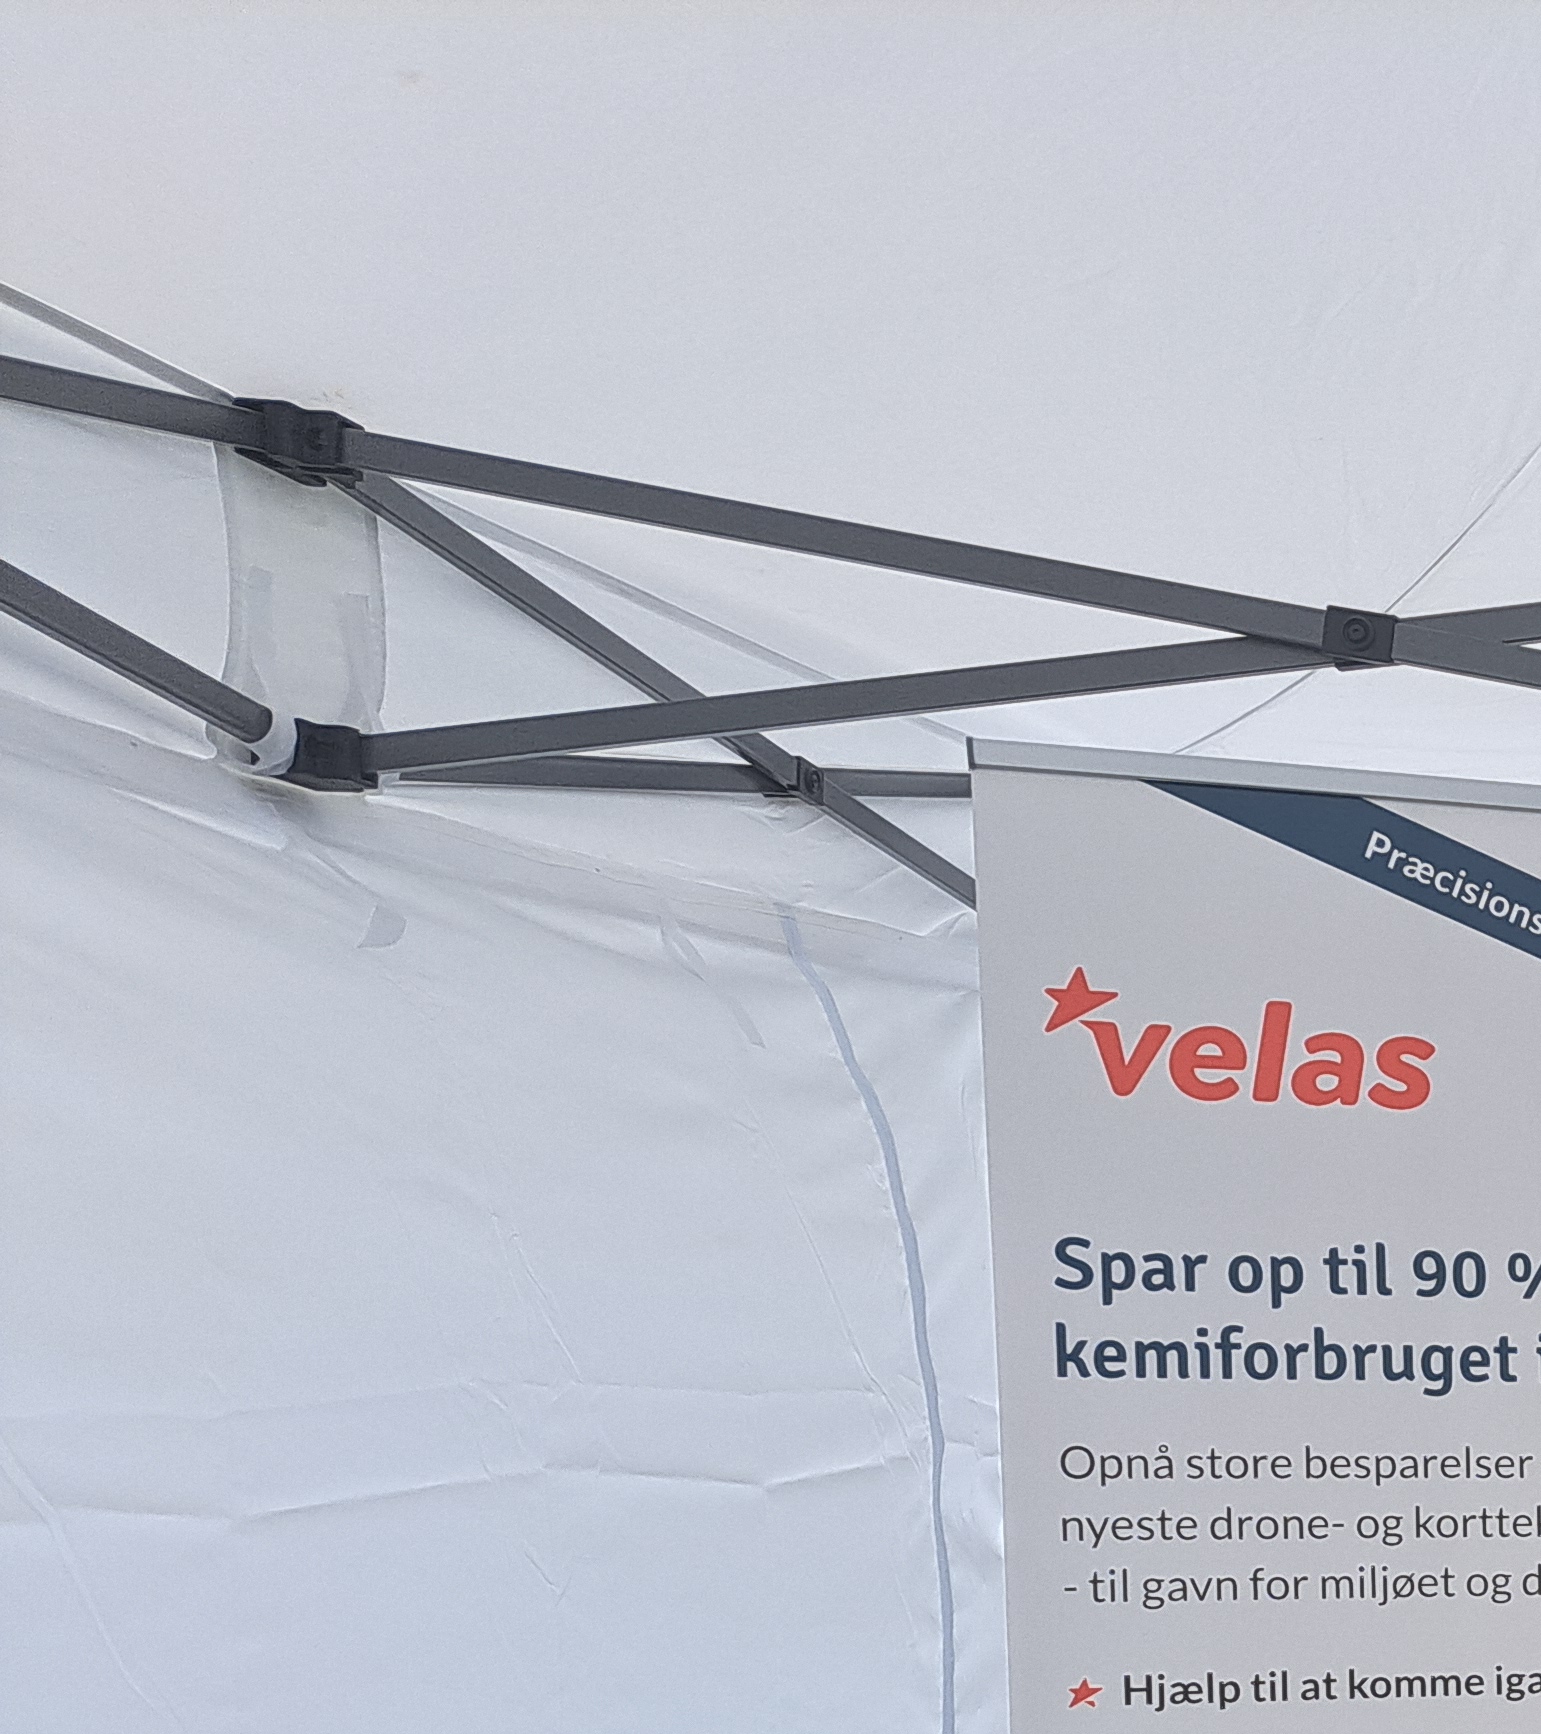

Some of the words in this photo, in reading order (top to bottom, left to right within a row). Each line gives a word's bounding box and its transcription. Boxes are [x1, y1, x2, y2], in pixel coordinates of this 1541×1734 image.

[1078, 1000, 1436, 1110] velas
[1054, 1236, 1208, 1306] Spar
[1228, 1254, 1304, 1310] op
[1322, 1241, 1393, 1297] til
[1412, 1249, 1487, 1299] 90
[1055, 1321, 1518, 1397] kemiforbruget
[1060, 1444, 1174, 1487] Opnå
[1186, 1448, 1292, 1480] store
[1305, 1445, 1534, 1487] besparelser
[1061, 1509, 1198, 1549] nyeste
[1209, 1506, 1345, 1541] drone-
[1356, 1515, 1404, 1547] og
[1088, 1568, 1129, 1604] til
[1142, 1577, 1238, 1610] gavn
[1249, 1567, 1309, 1601] for
[1321, 1565, 1456, 1607] miljøet
[1466, 1573, 1512, 1604] og
[1123, 1672, 1241, 1713] Hjælp
[1250, 1670, 1289, 1703] til
[1300, 1672, 1338, 1701] at
[1348, 1668, 1485, 1700] komme
